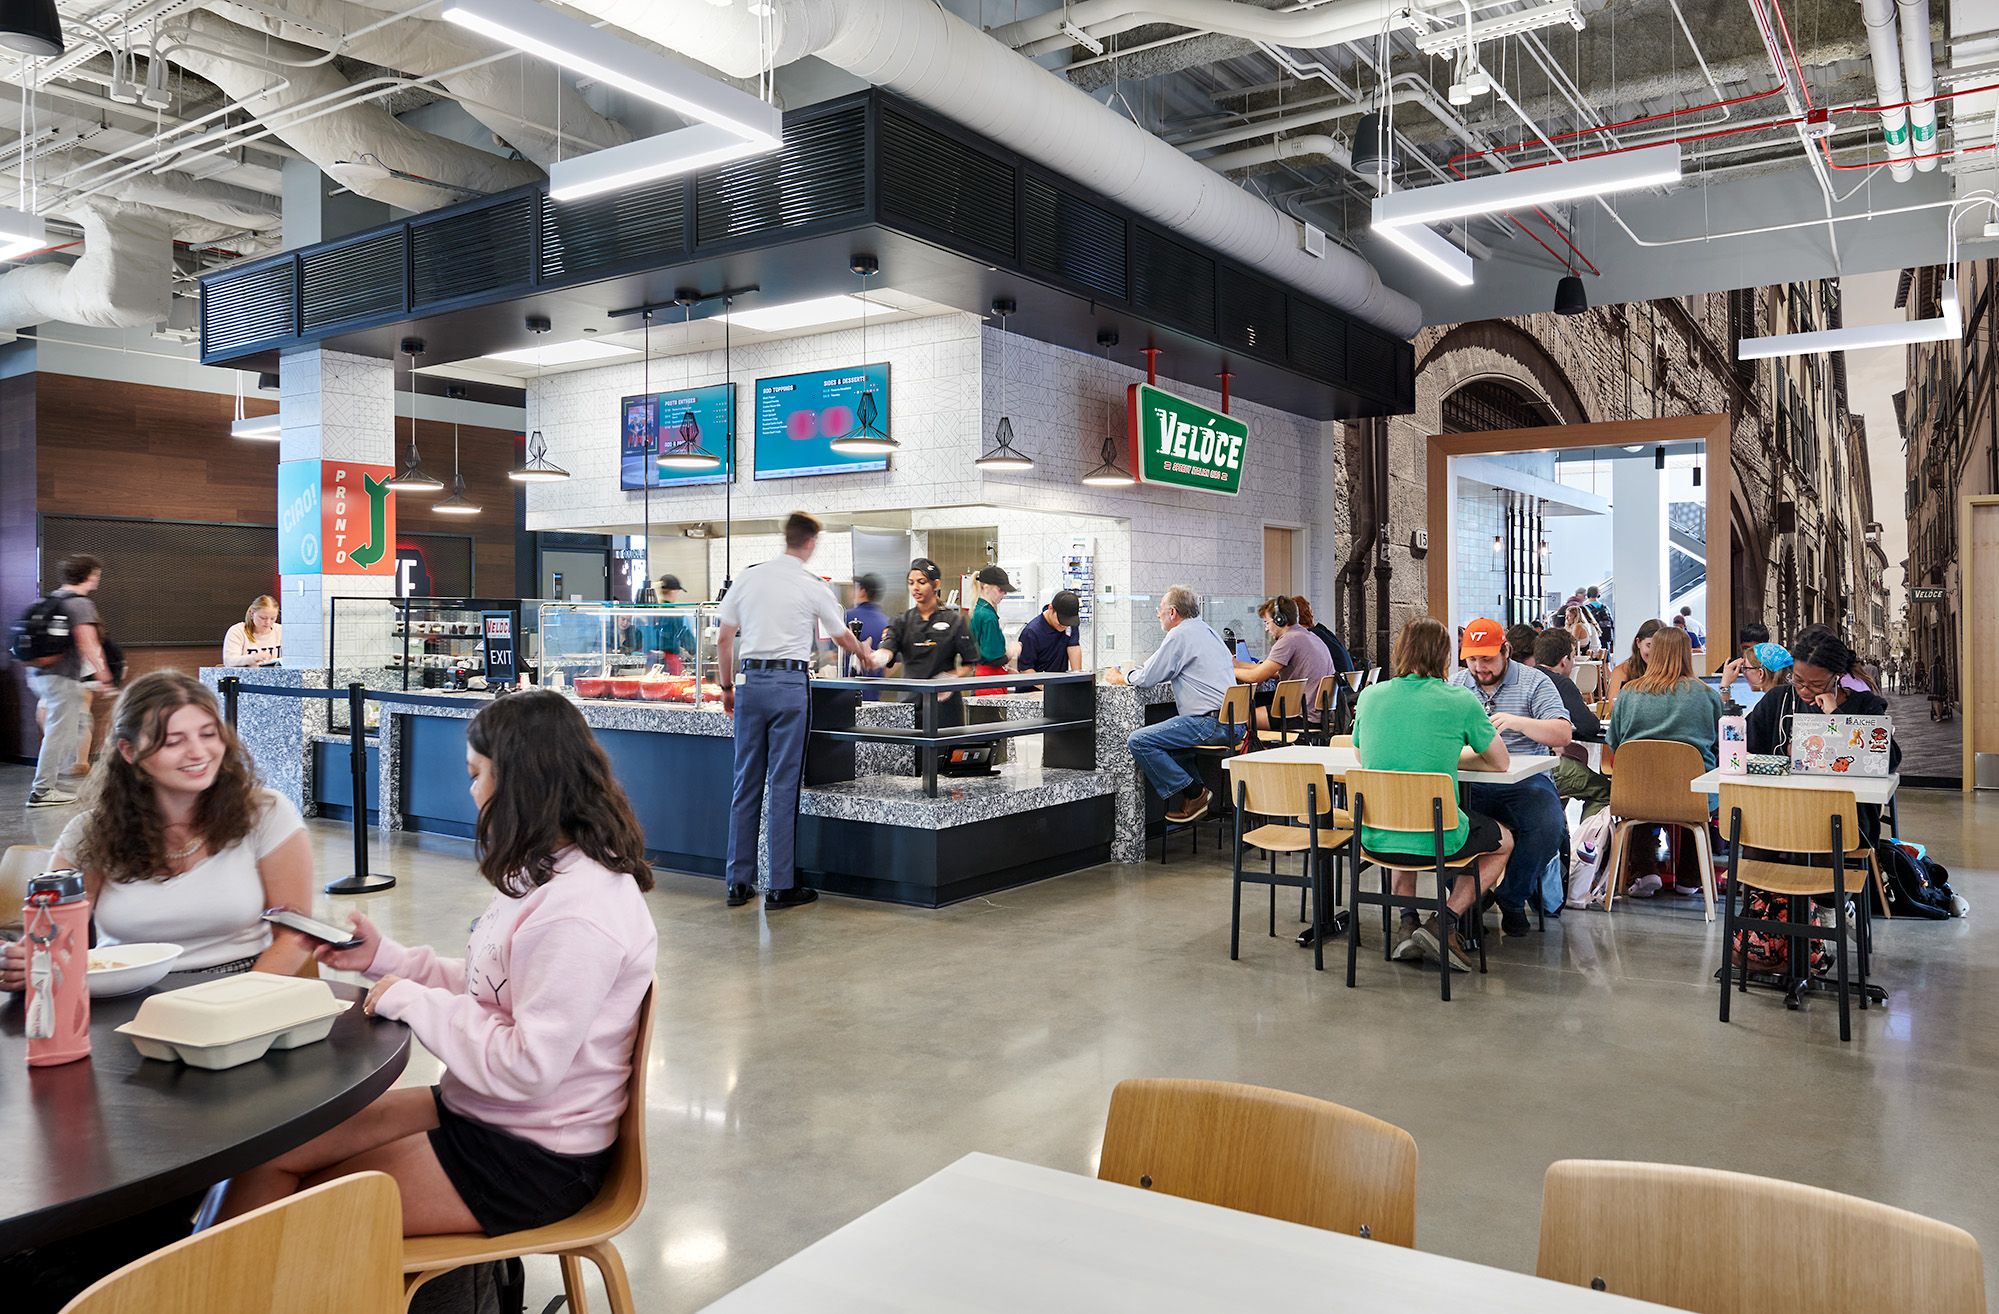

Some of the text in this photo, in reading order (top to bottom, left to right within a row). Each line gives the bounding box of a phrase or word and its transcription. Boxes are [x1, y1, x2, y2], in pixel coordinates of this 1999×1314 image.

[283, 482, 318, 535] CIAO!
[335, 469, 346, 564] PRONTO
[1419, 533, 1428, 546] 15
[1470, 632, 1488, 642] VT
[490, 650, 512, 665] EXIT
